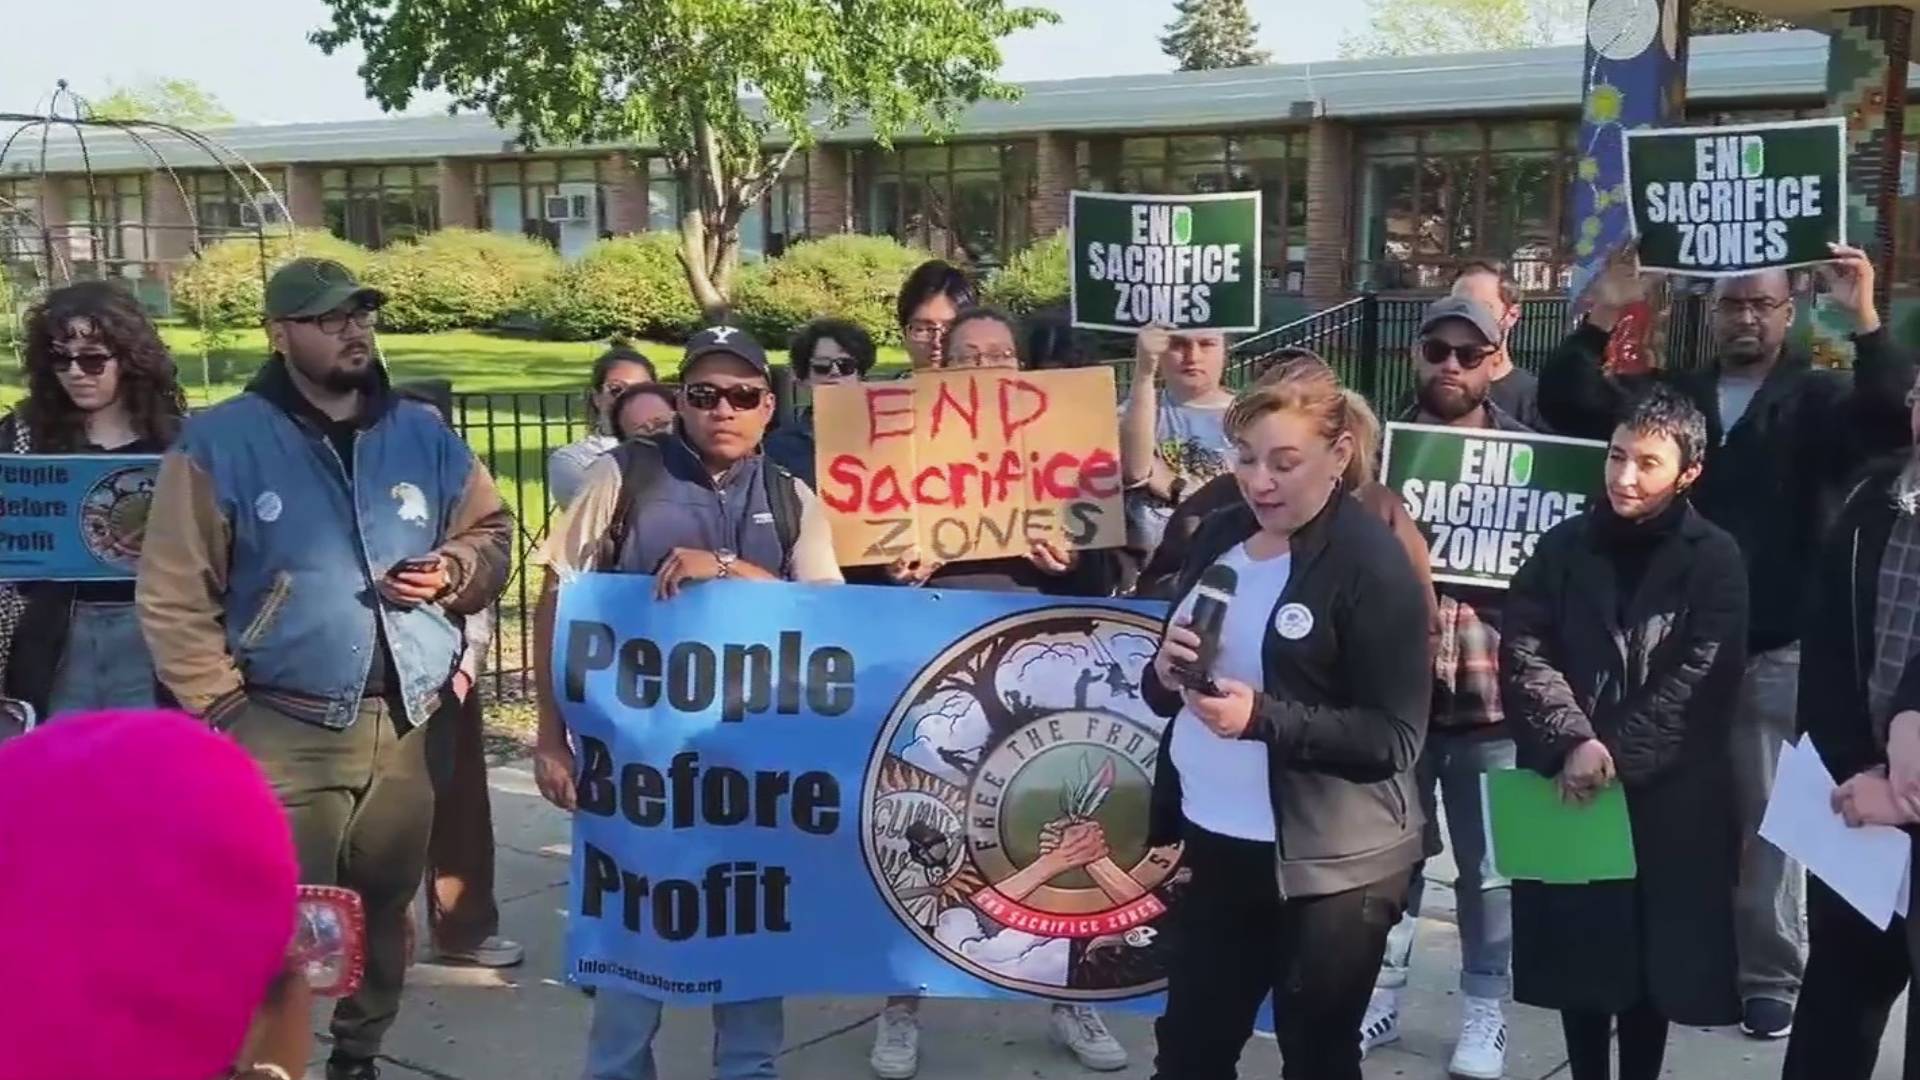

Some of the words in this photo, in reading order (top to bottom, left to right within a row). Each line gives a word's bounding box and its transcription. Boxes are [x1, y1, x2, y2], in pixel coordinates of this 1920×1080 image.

[1695, 135, 1764, 180] END
[1645, 175, 1822, 223] SACRIFICE
[1131, 204, 1192, 245] END
[1677, 220, 1788, 265] ZONES
[1087, 241, 1240, 284] SACRIFICE
[1114, 283, 1211, 324] ZONES
[705, 325, 739, 344] Y
[866, 376, 1047, 445] END
[820, 448, 1119, 513] Sacrifice
[1460, 438, 1533, 487] END
[1402, 478, 1586, 533] SACRIFICE
[862, 502, 1104, 559] ZONES
[565, 619, 855, 723] People
[1006, 719, 1063, 760] THE
[576, 735, 840, 835] Before
[582, 841, 791, 942] Profit
